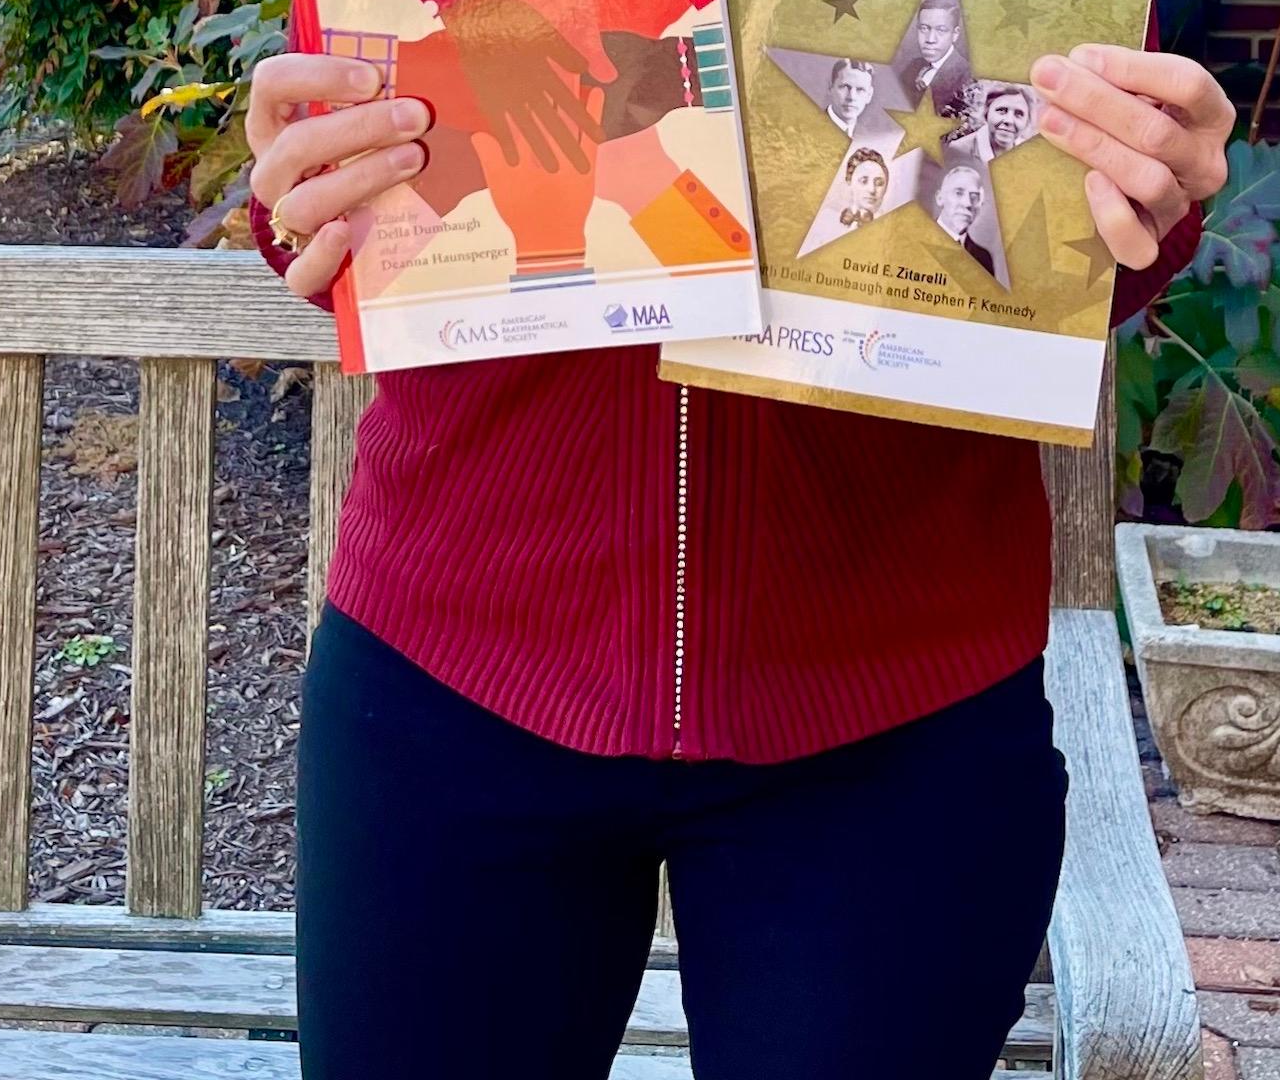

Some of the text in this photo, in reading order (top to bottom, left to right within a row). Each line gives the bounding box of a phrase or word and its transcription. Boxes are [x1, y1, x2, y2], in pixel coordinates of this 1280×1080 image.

[377, 217, 481, 241] Della Dumbaugh
[380, 243, 398, 256] and
[381, 247, 510, 272] Deanna Haunsperger
[843, 257, 947, 287] David E. Zitarelli
[781, 266, 813, 283] Della
[815, 270, 883, 295] Dumbaugh
[886, 284, 910, 301] and
[913, 287, 965, 308] Stephen
[968, 296, 978, 309] F.
[980, 299, 1037, 321] Kennedy
[501, 313, 546, 326] AMERICAN
[632, 304, 670, 326] MAA
[454, 323, 498, 345] AMS
[502, 321, 569, 334] MATHEMATICAL
[503, 332, 538, 343] SOCIETY
[776, 326, 835, 357] PRESS
[879, 342, 924, 356] AMERICAN
[877, 358, 909, 370] SOCIETY
[878, 350, 942, 368] MATHEMATICAL
